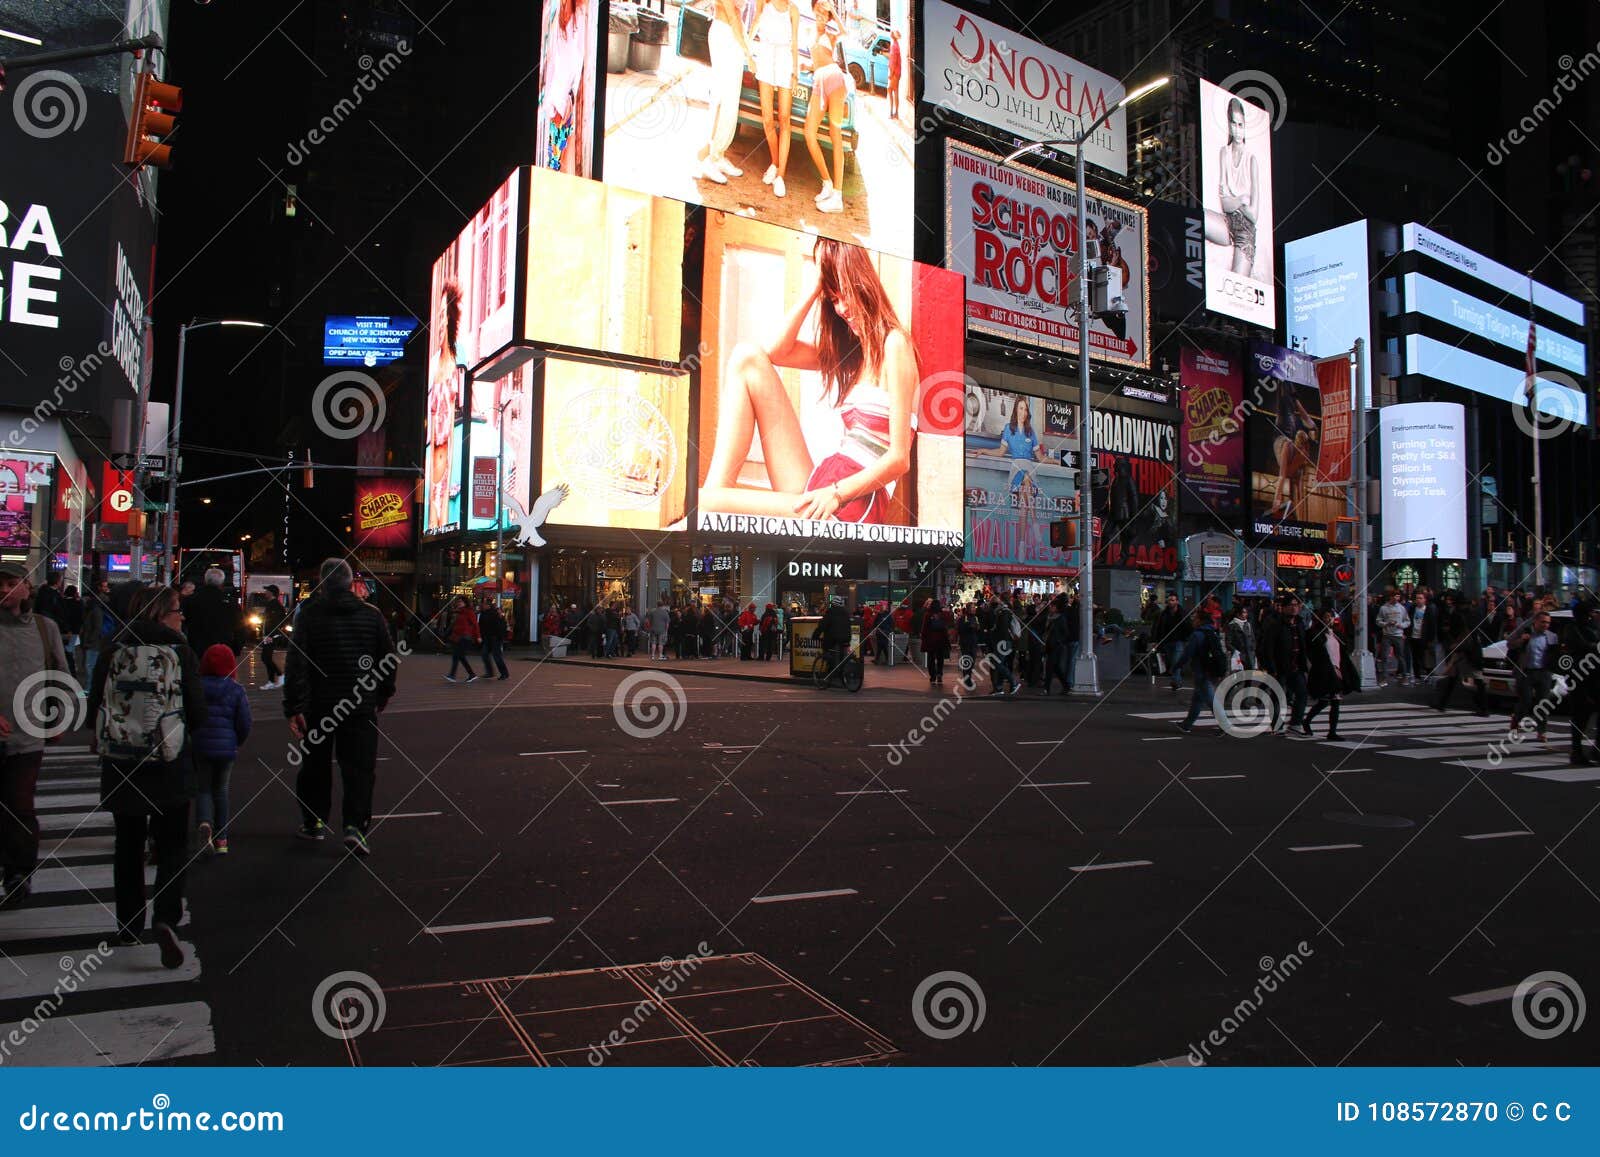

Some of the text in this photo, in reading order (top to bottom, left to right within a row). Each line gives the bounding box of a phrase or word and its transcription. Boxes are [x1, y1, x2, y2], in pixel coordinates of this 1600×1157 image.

[951, 14, 1112, 130] WRONG
[943, 67, 1000, 108] GOES
[1004, 95, 1044, 123] THAT
[1046, 110, 1075, 139] LAY
[989, 165, 1014, 186] LLOYD
[1016, 175, 1045, 198] WEBBER
[1047, 186, 1061, 203] HAS
[1021, 236, 1043, 265] of
[1185, 217, 1203, 289] NEW
[1417, 233, 1460, 264] Environmental
[1023, 299, 1044, 308] MUSICAL
[990, 308, 1006, 322] JUST
[1007, 313, 1013, 323] 4
[1013, 314, 1037, 329] BLOCKS
[1038, 319, 1046, 331] TO
[1047, 321, 1058, 334] THE
[118, 495, 128, 507] P
[361, 493, 400, 517] CHARLIE
[970, 489, 1005, 506] SARA
[1011, 493, 1073, 514] BAREILLES
[702, 513, 963, 547] AMERICAN EAGLE OUTFITTERS
[1255, 522, 1274, 534] LYRIC
[1279, 525, 1303, 537] THEATRE
[789, 561, 843, 578] DRINK
[1279, 554, 1291, 566] DOS
